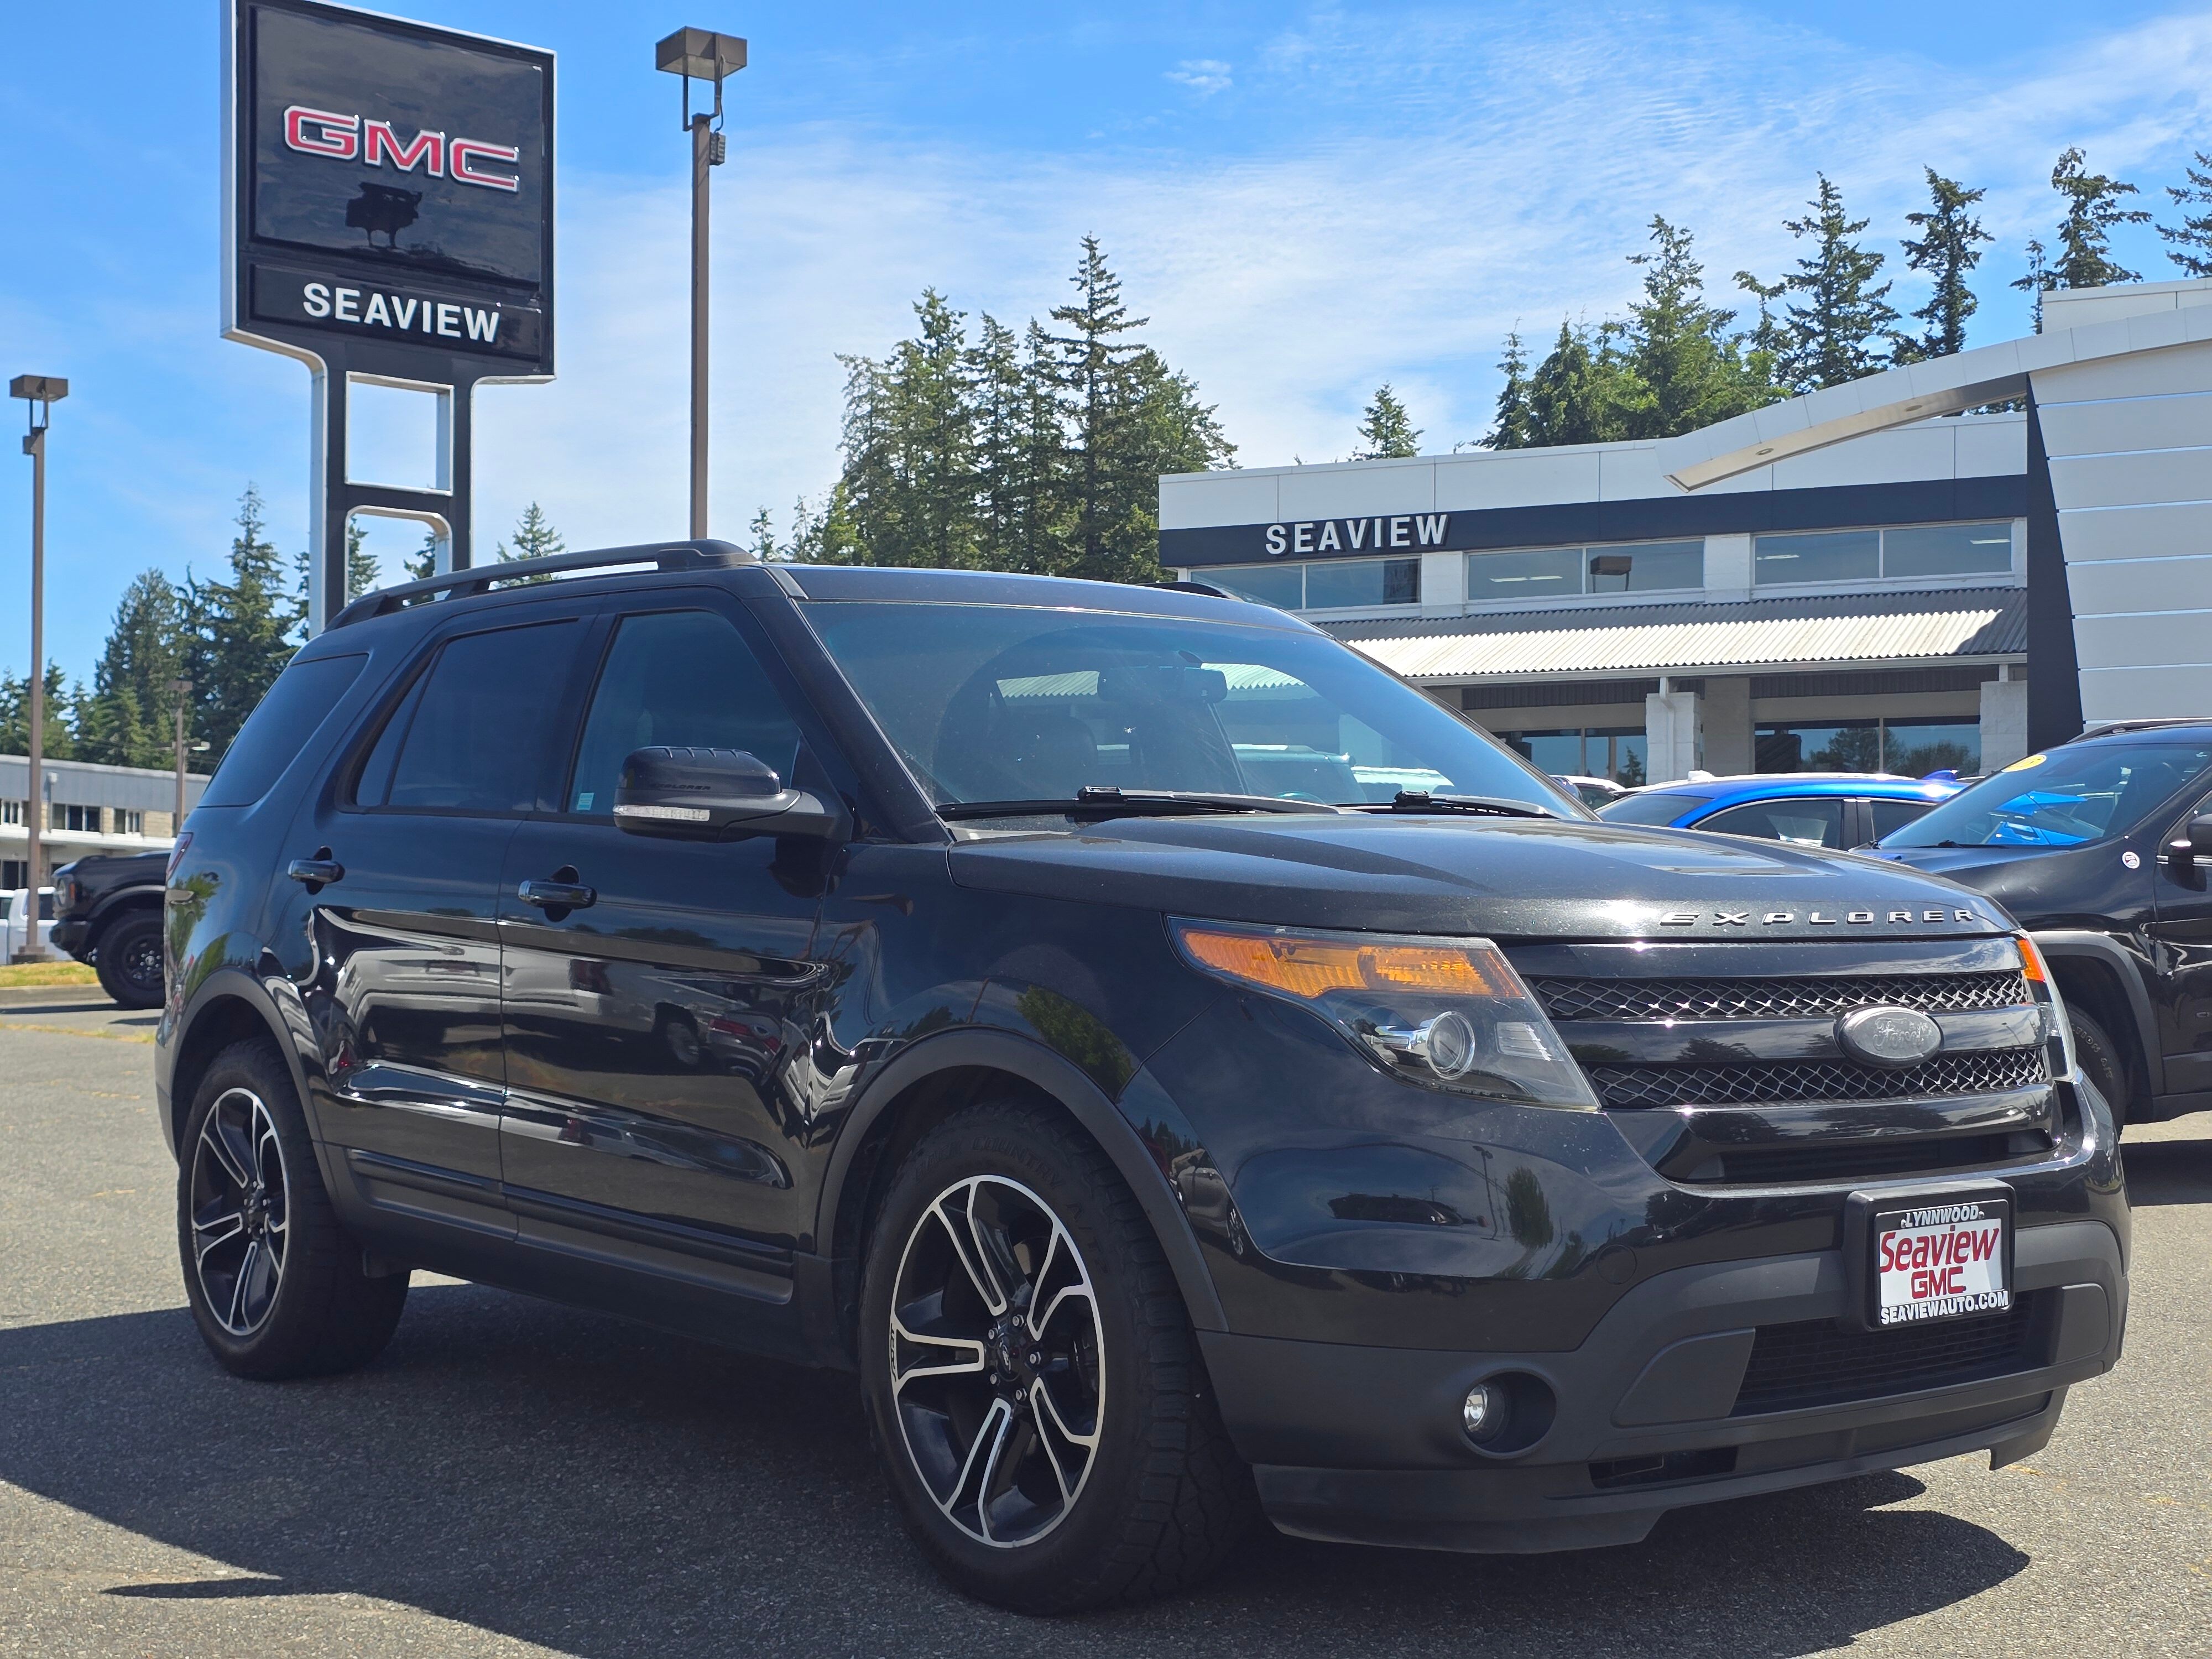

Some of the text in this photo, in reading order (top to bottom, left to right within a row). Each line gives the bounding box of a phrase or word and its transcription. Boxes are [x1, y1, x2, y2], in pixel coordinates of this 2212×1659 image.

[284, 105, 519, 192] GMC
[302, 283, 499, 343] SEAVIEW
[1265, 514, 1449, 555] SEAVIEW
[1659, 909, 1974, 926] EXPLORER
[1906, 1205, 1979, 1228] LYNNWOOD
[1880, 1225, 2000, 1272] Seaview
[1911, 1266, 1966, 1300] GMC
[1881, 1290, 2008, 1325] SEAVIEWAUTO.COM
